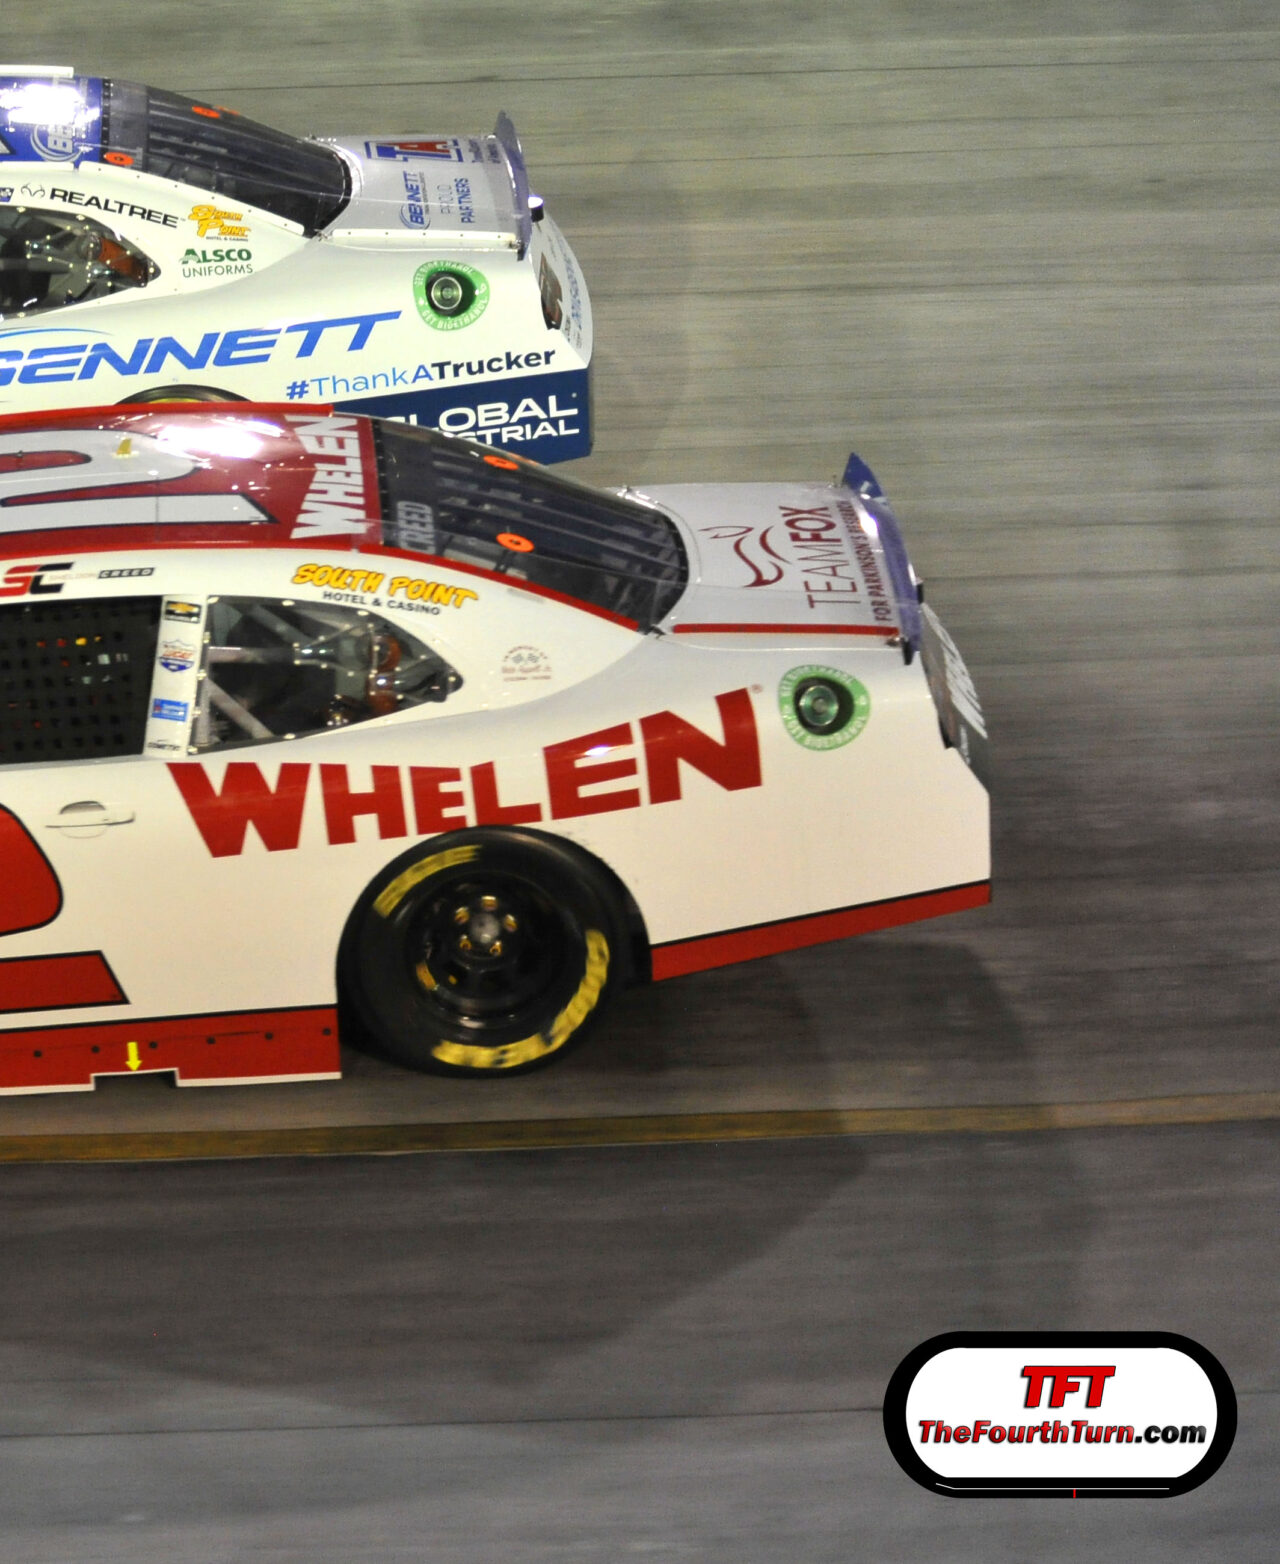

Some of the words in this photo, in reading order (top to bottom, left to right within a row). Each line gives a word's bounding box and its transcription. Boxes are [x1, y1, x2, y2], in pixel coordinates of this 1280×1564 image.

[50, 188, 179, 229] REALTREE
[197, 219, 251, 238] POINT
[180, 248, 252, 265] ALSCO
[182, 263, 253, 278] UNIFORMS
[286, 349, 556, 400] #ThankATrucker
[284, 415, 368, 539] WHELEN
[397, 500, 437, 555] CREED
[100, 568, 152, 578] CREED
[292, 563, 385, 593] SOUTH
[388, 576, 479, 609] POINT
[850, 535, 886, 597] PARKINSON'S
[323, 591, 367, 606] HOTEL
[371, 597, 382, 607] &
[387, 600, 441, 616] CASINO
[870, 599, 893, 621] FOR
[166, 688, 763, 858] WHELEN
